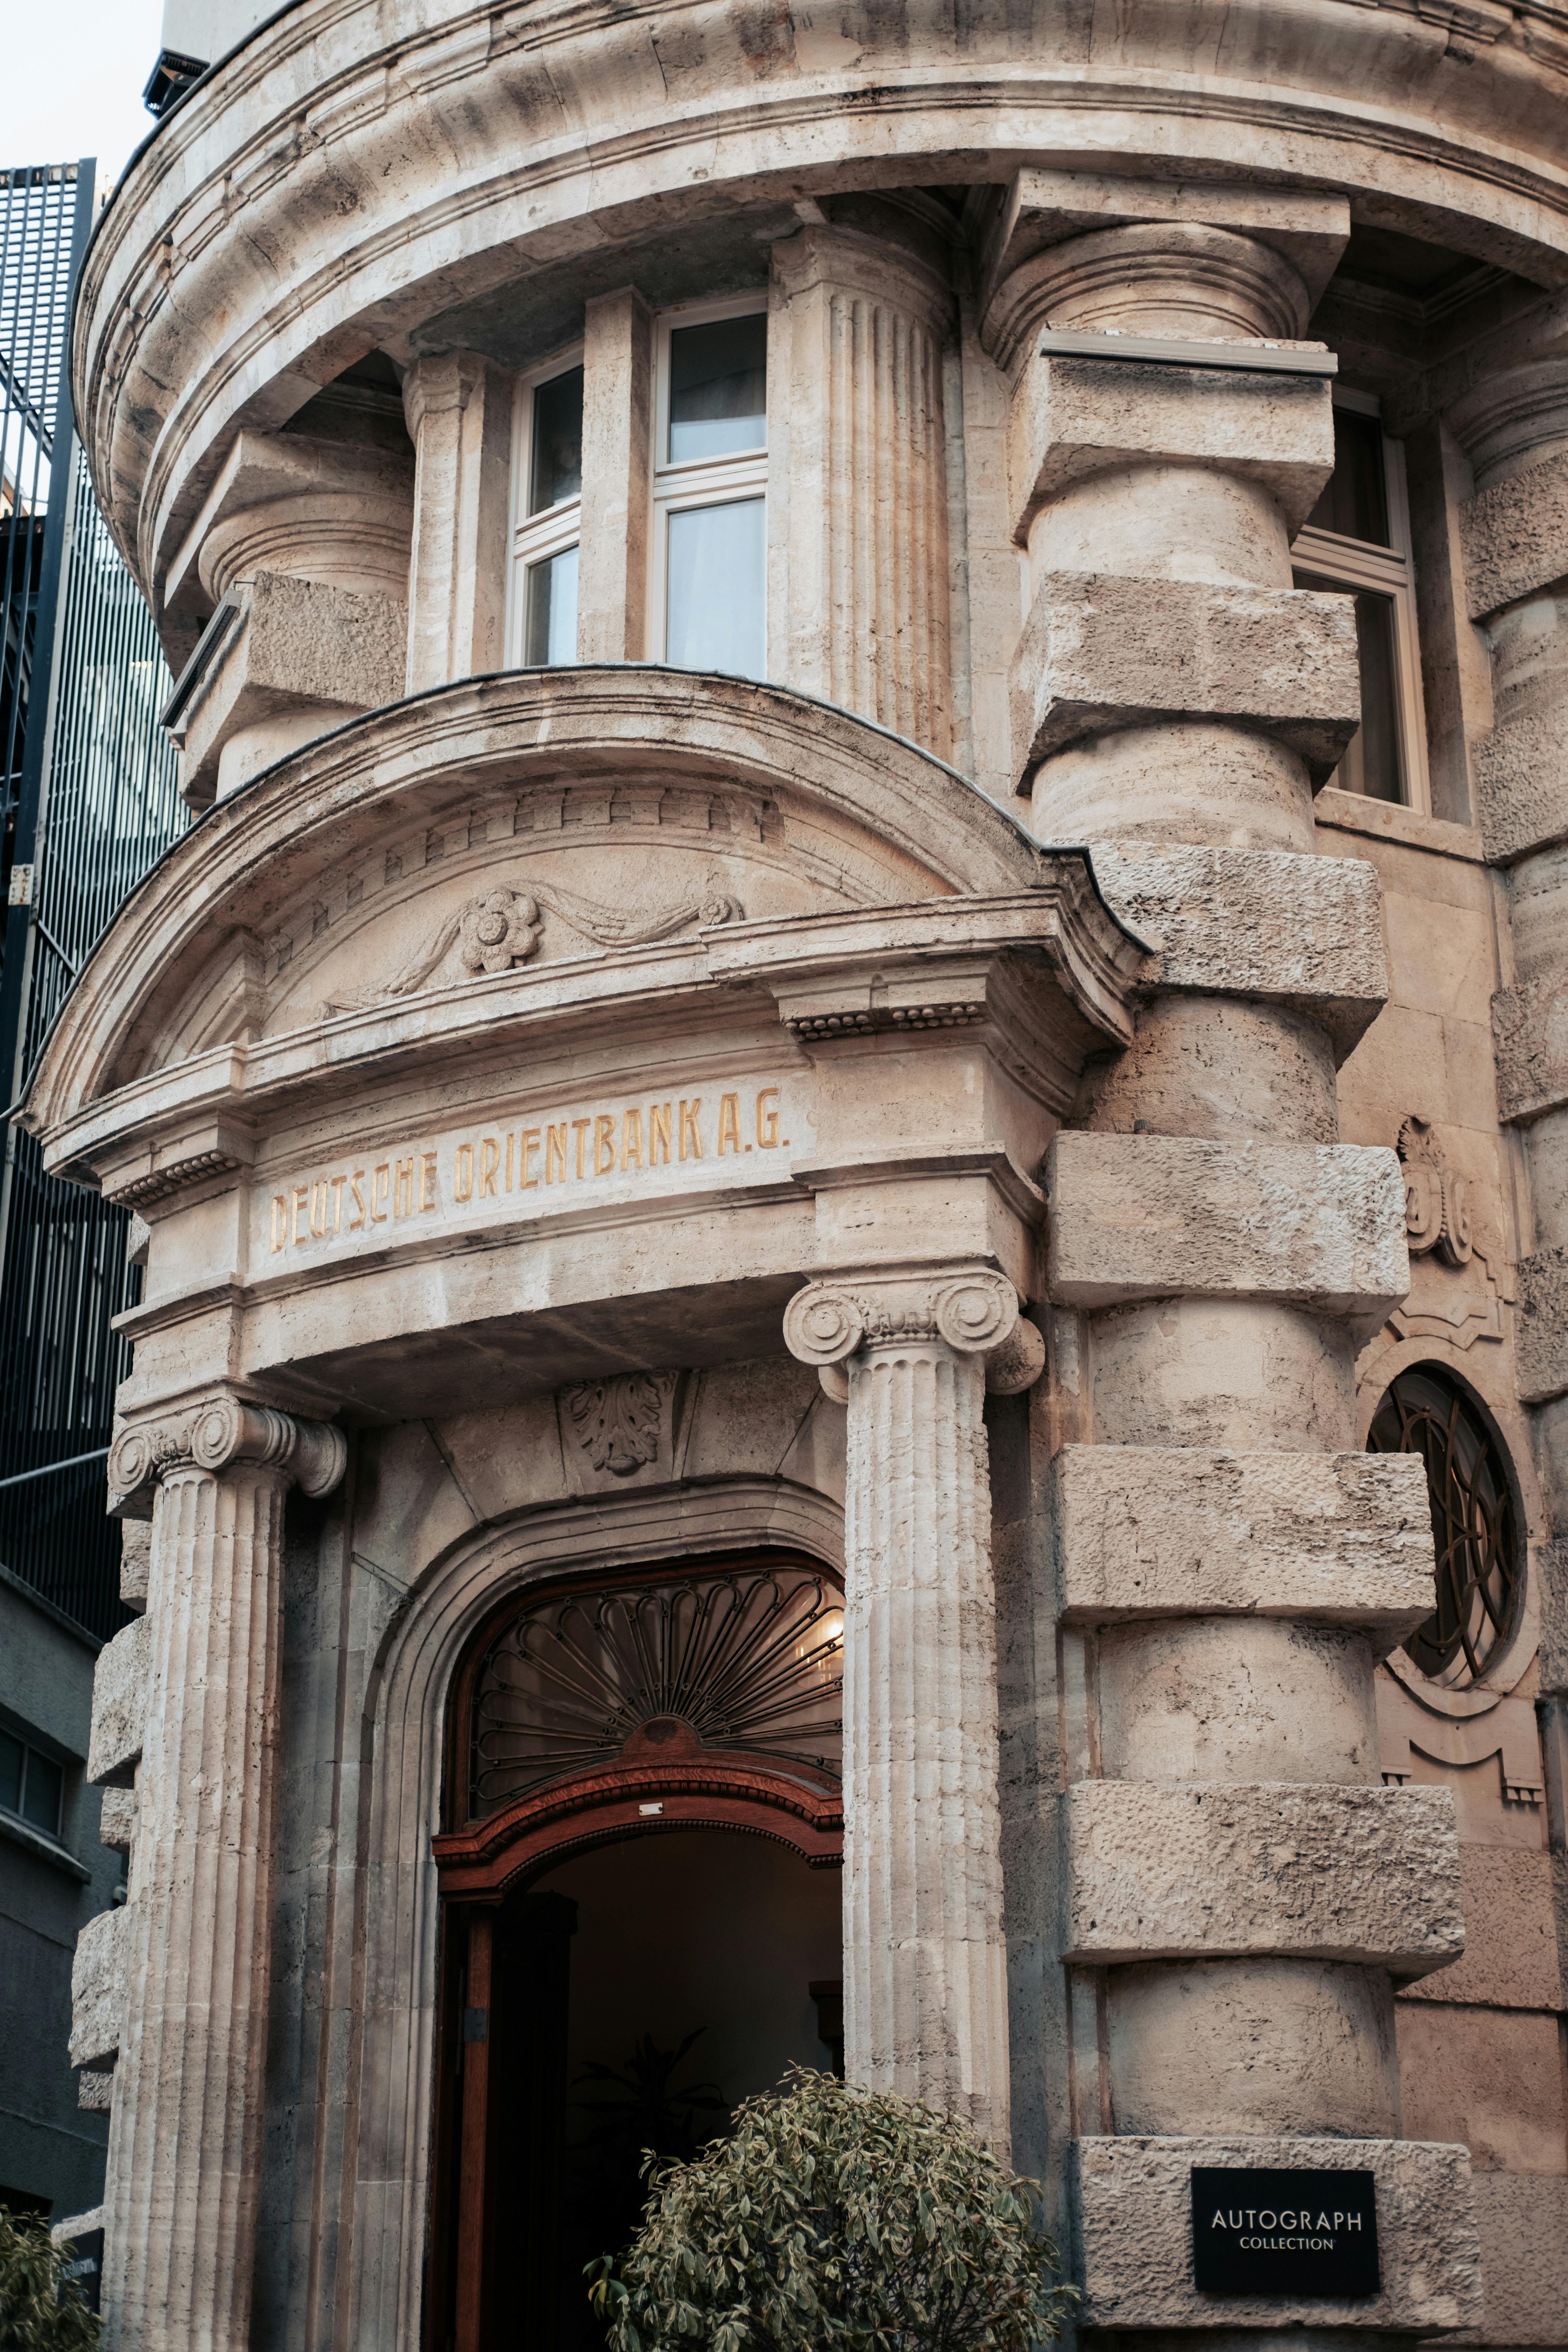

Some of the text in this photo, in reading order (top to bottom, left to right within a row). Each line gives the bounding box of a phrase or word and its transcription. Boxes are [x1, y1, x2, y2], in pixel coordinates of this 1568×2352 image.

[270, 1087, 790, 1254] DEUTSCHE ORIENTBANK A.G.
[1211, 2209, 1362, 2231] AUTOGRAPH
[1240, 2237, 1333, 2250] COLLECTION
